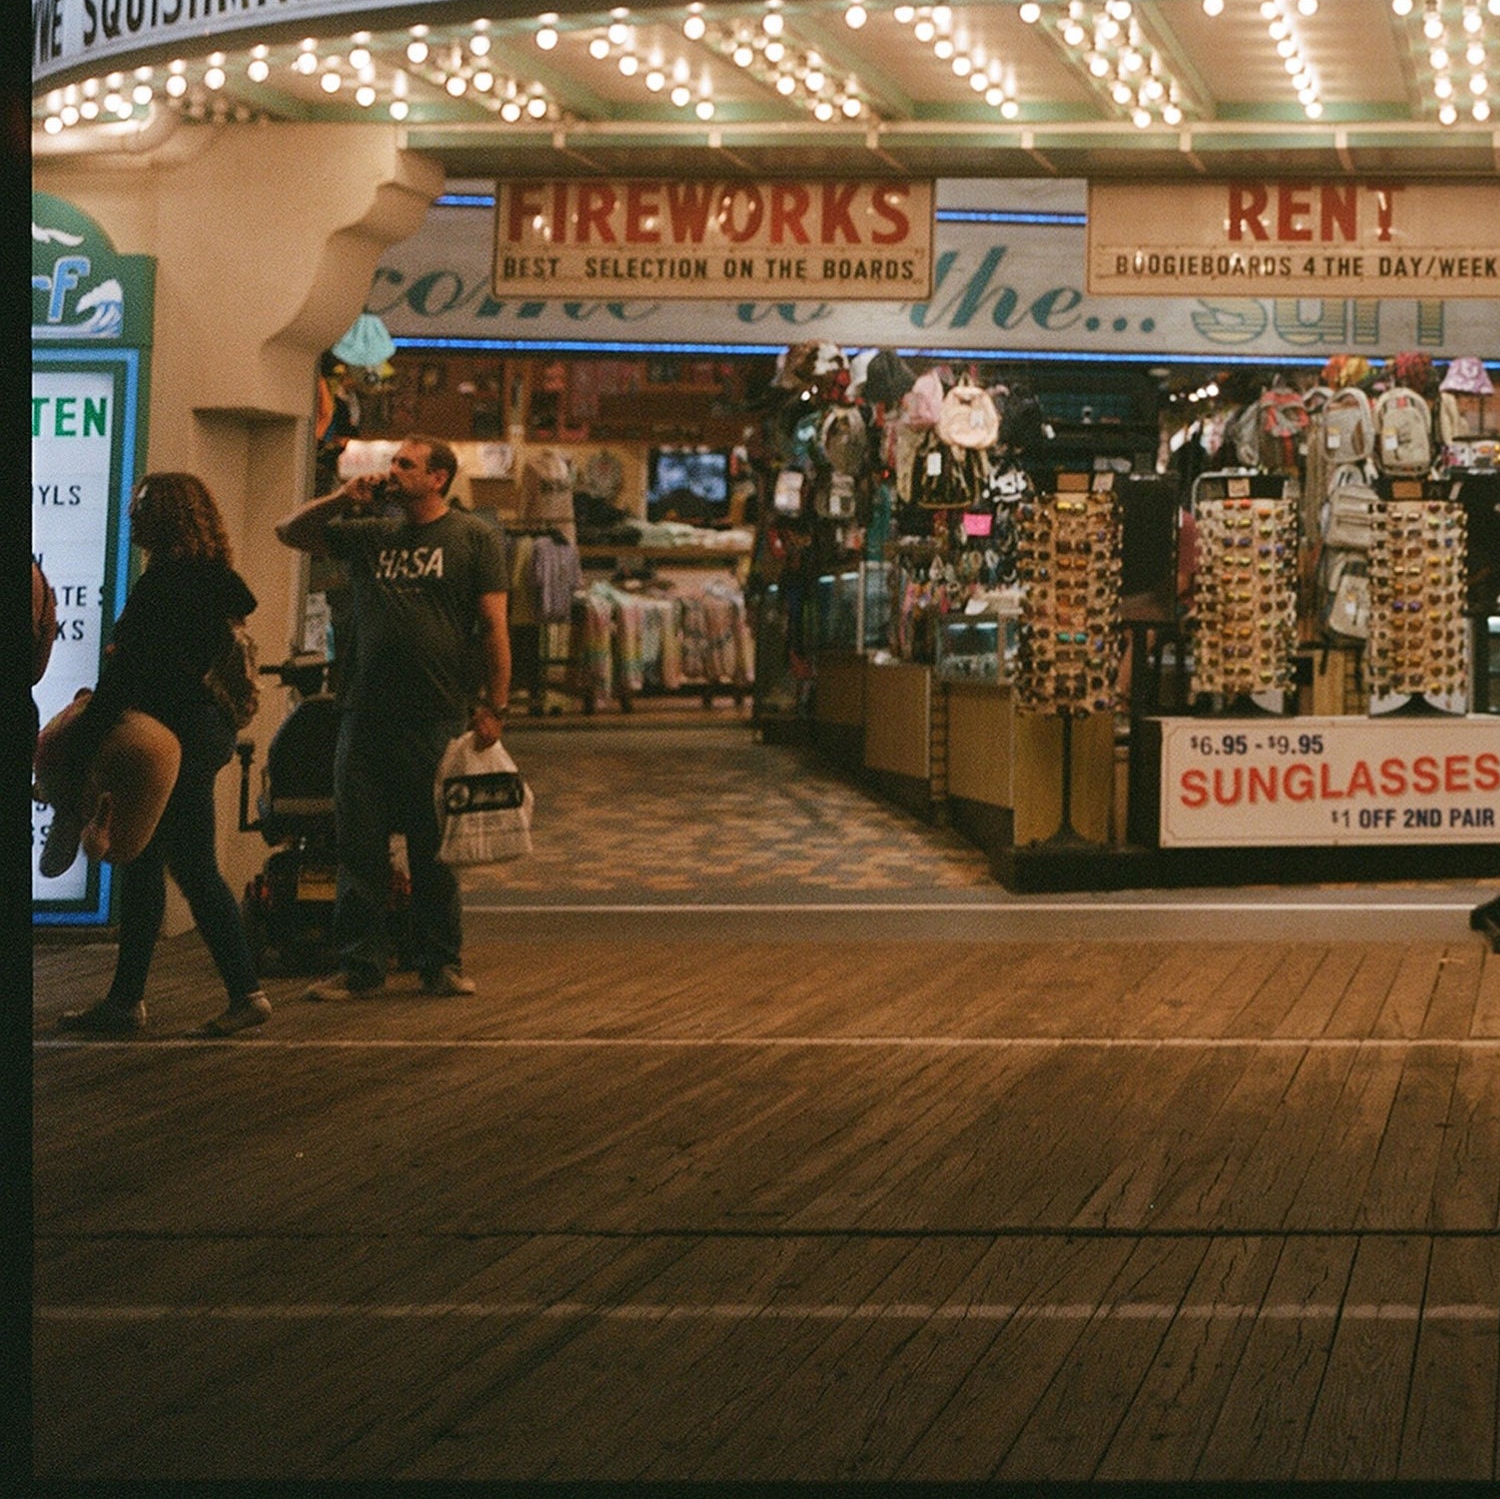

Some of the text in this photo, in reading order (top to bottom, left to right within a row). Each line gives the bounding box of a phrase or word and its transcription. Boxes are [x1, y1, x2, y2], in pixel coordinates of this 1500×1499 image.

[507, 180, 911, 245] FIREWORKS
[1228, 182, 1404, 242] RENT
[503, 257, 914, 280] BEST SELECTION ON THE BOARDS
[1116, 255, 1498, 278] BOOGIEBOARDS 4 THE DAY/WEEK
[1191, 735, 1248, 755] $6.95
[1268, 734, 1324, 755] $9.95
[1331, 808, 1495, 829] $1 OFF 2ND PAIR
